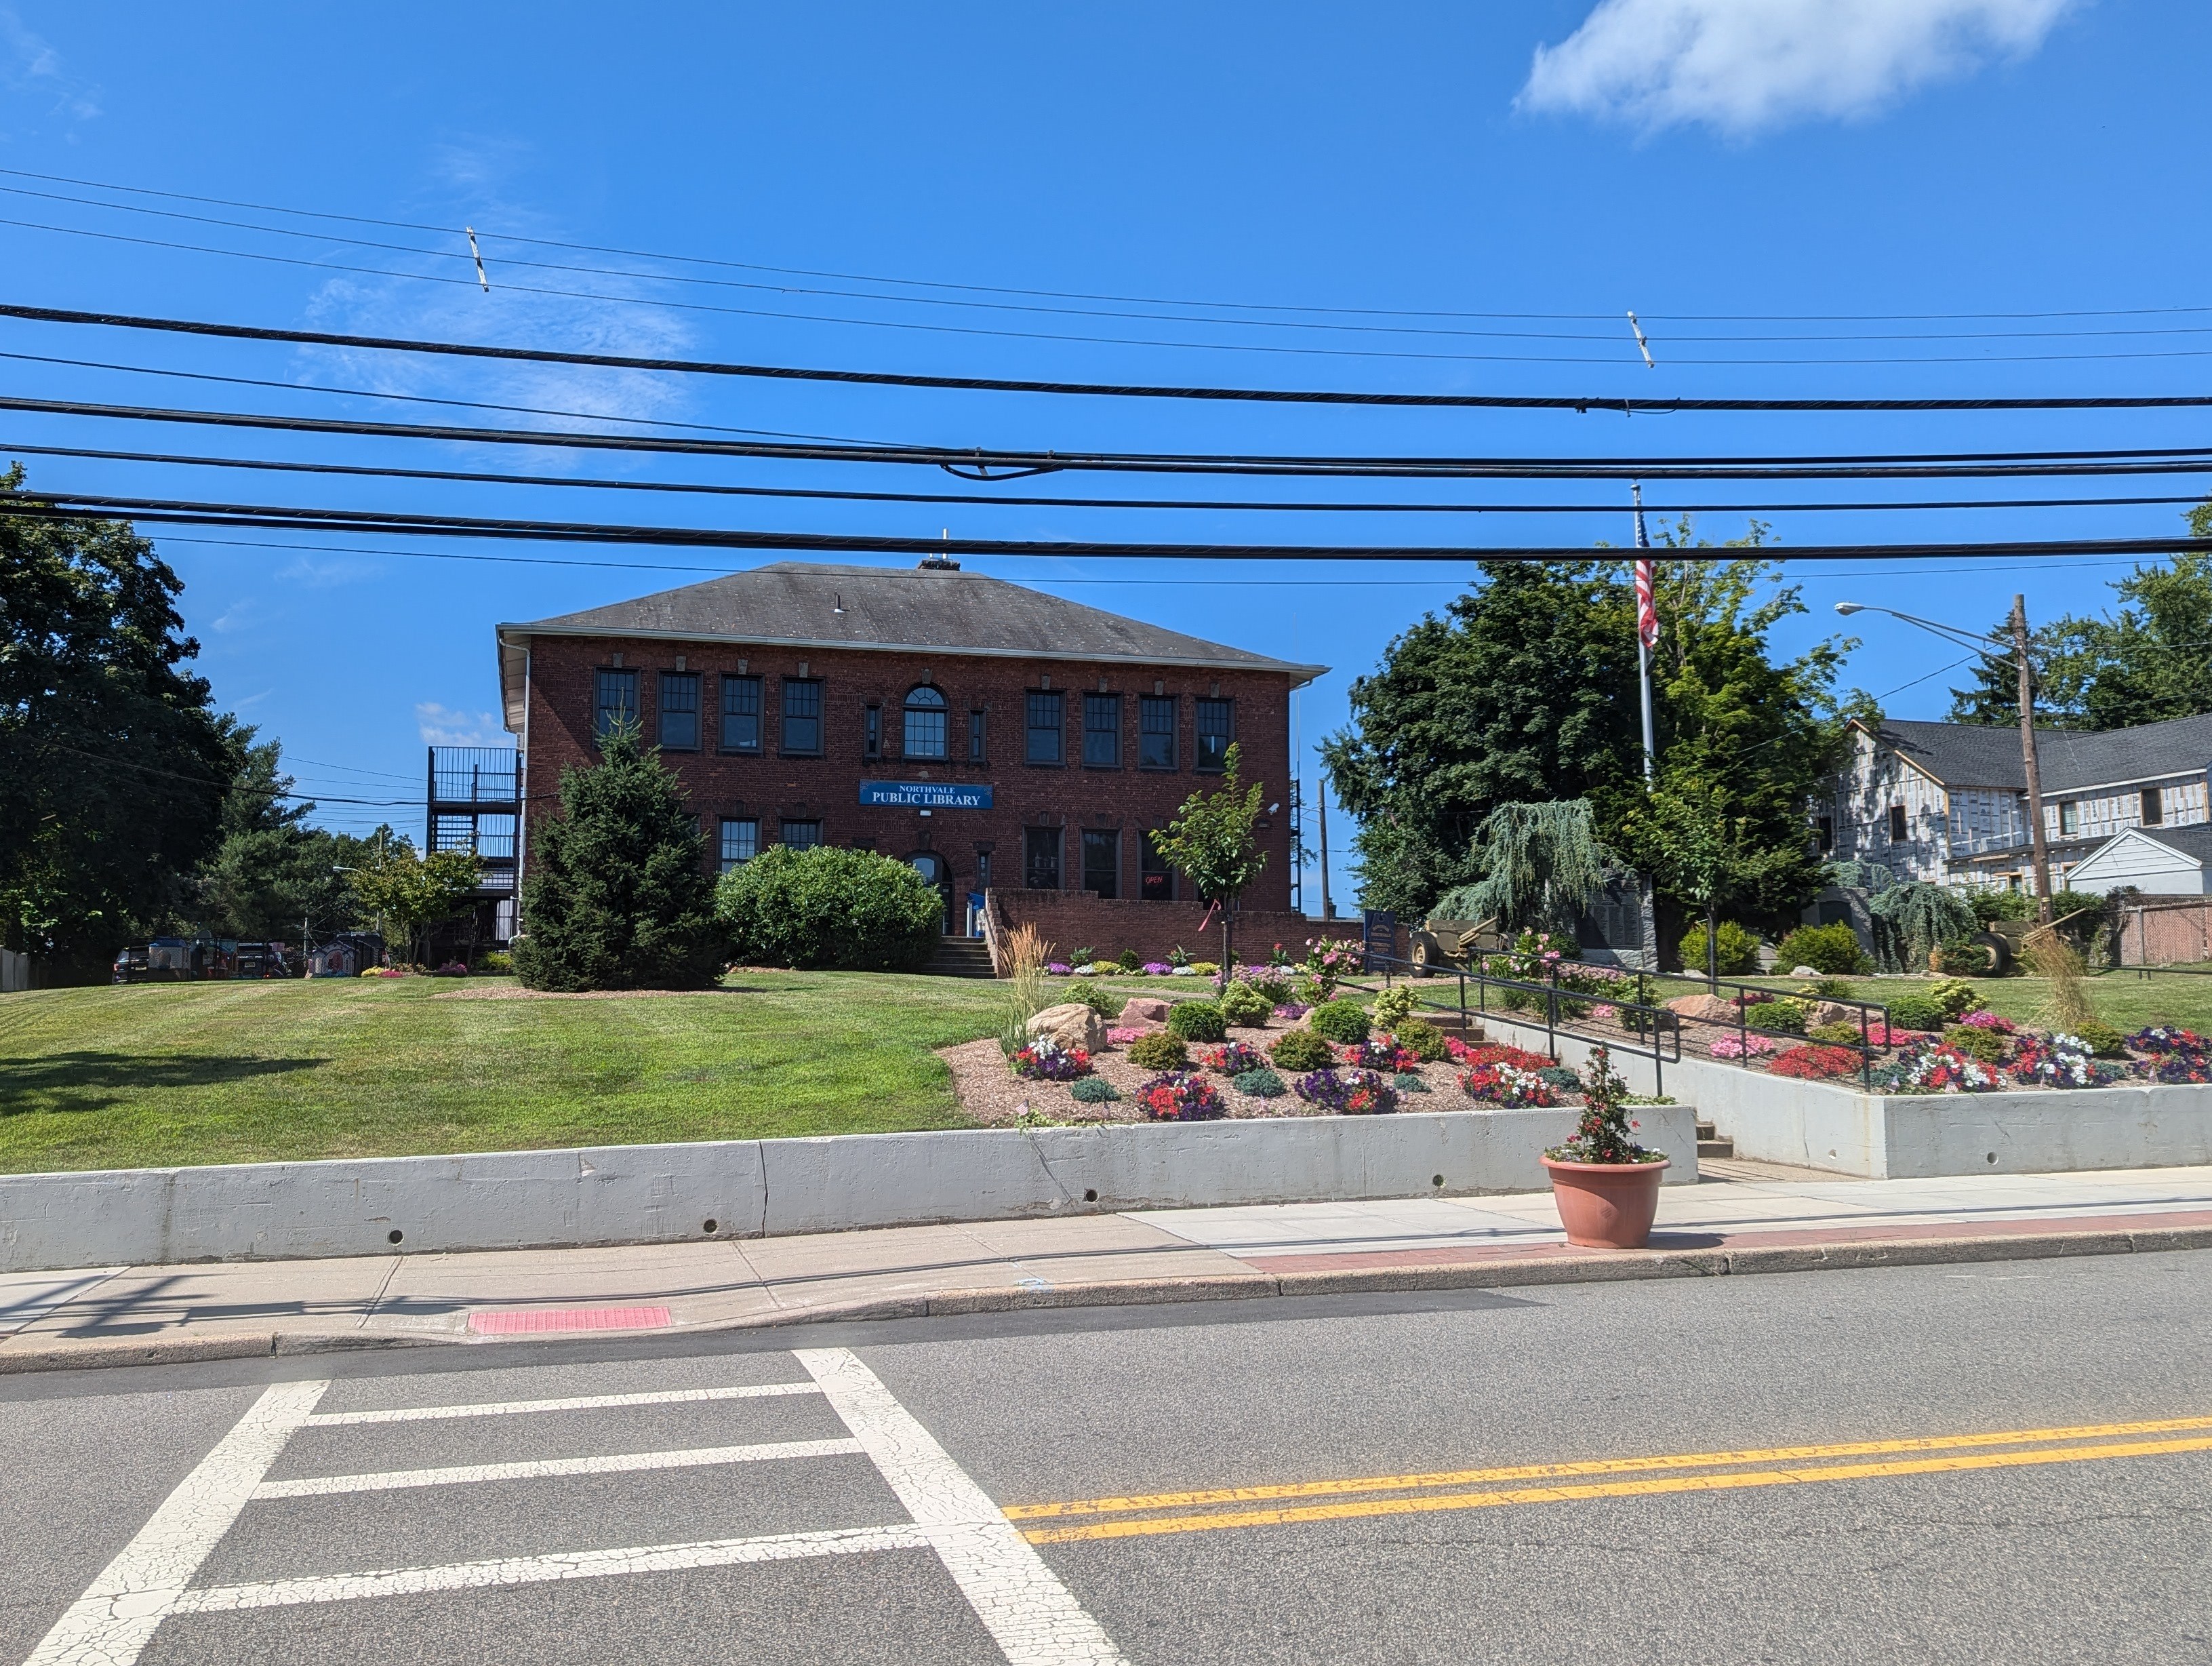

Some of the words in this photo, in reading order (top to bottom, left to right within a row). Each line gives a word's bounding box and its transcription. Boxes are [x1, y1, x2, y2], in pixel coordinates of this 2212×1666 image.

[899, 785, 955, 794] NORTHVALE
[872, 792, 921, 804] PUBLIC
[923, 793, 981, 806] LIBRARY
[1145, 876, 1163, 884] OPEN
